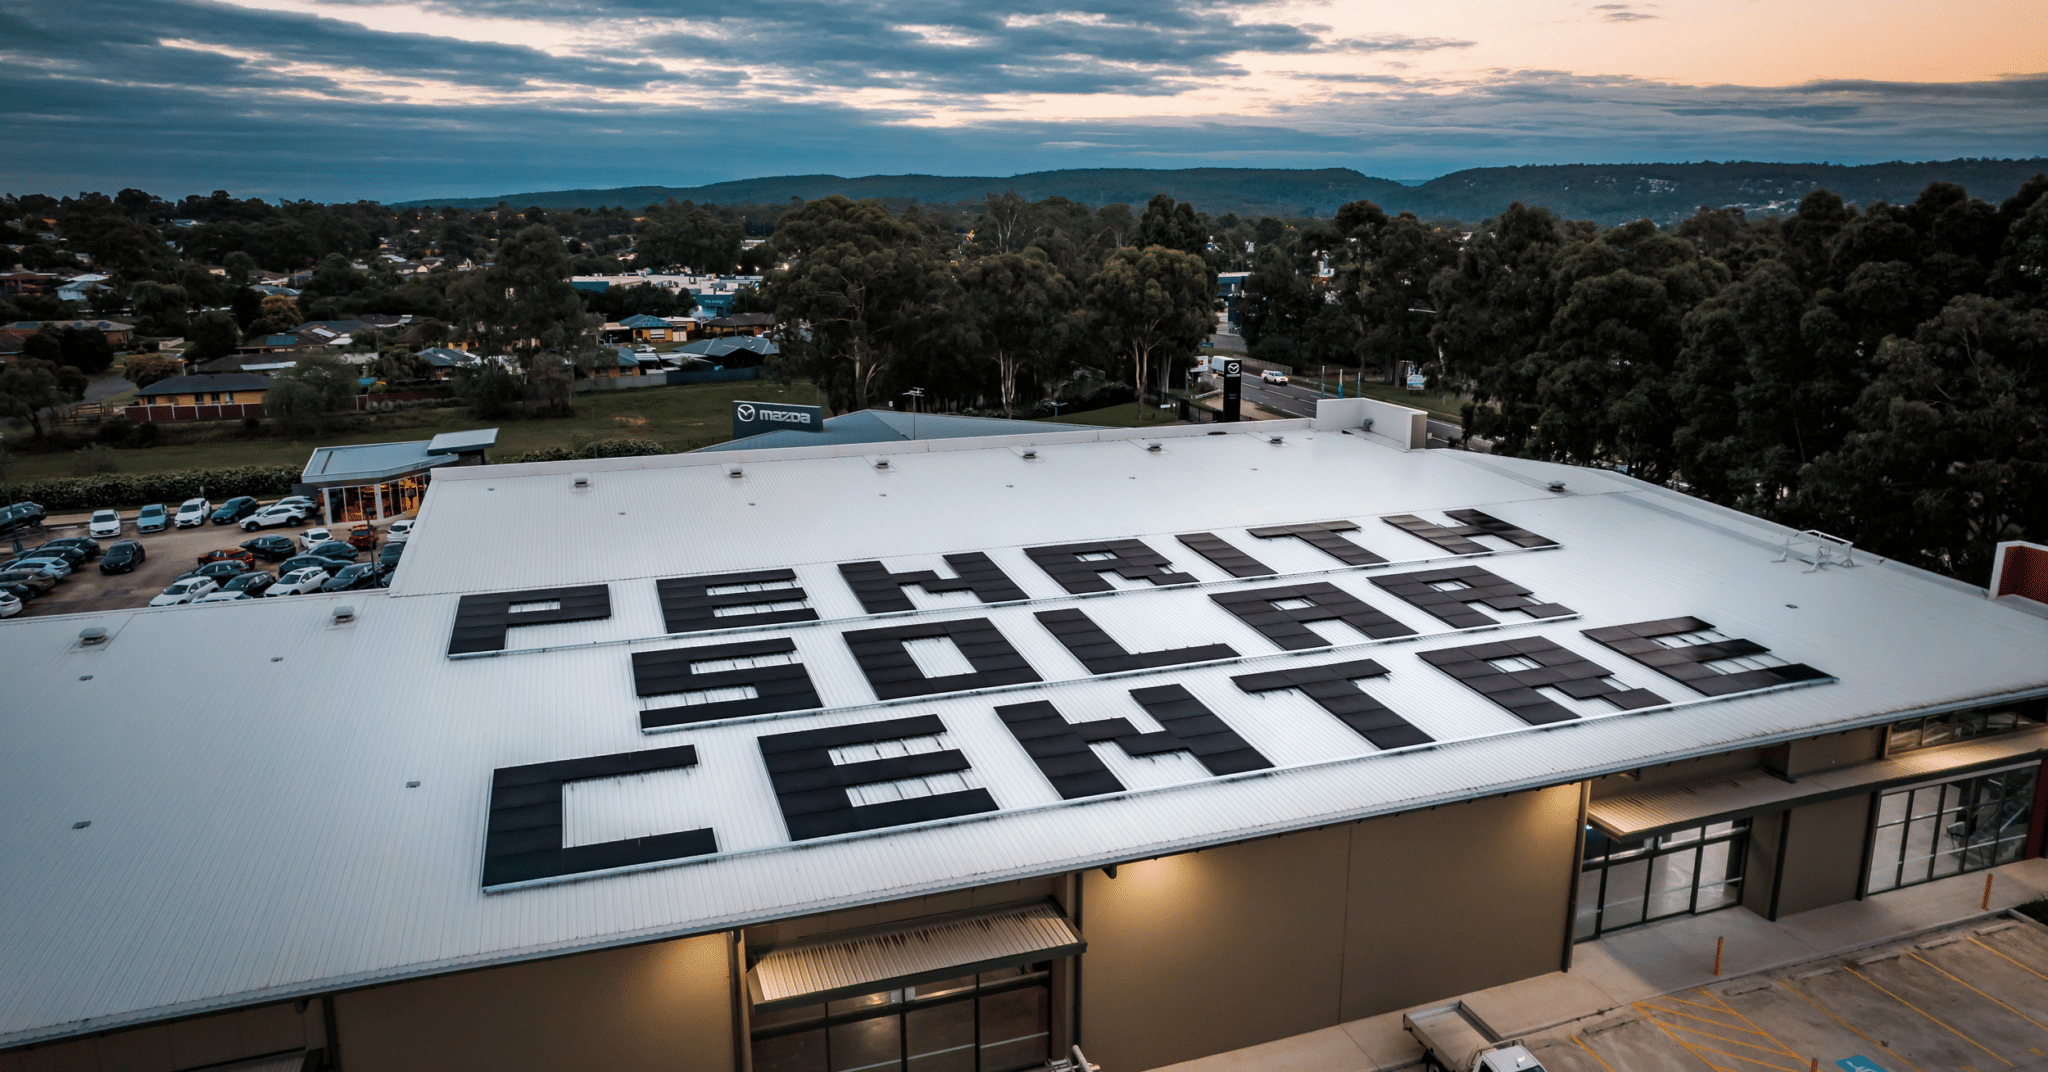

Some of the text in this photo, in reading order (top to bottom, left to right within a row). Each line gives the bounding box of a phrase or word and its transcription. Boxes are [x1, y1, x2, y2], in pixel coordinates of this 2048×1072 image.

[448, 508, 1561, 655] PENRITH
[631, 565, 1578, 731] SOLAR
[481, 616, 1835, 887] CENTRE
